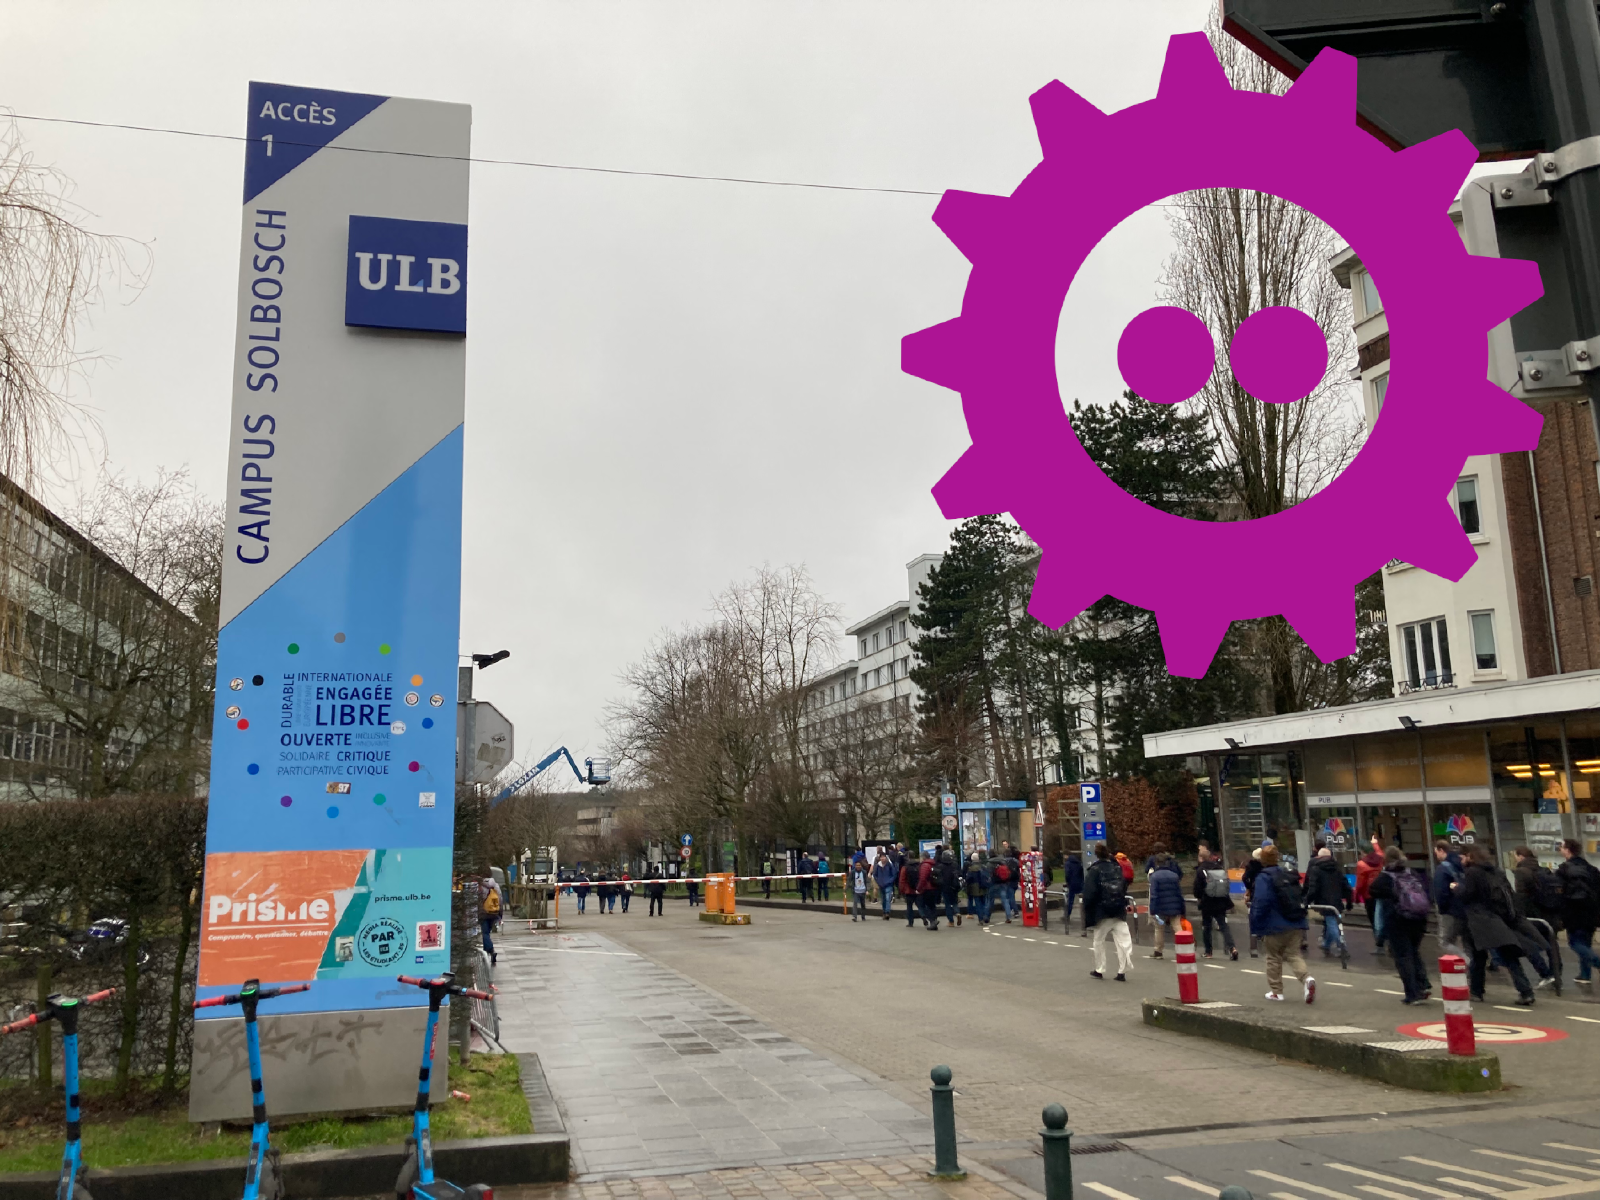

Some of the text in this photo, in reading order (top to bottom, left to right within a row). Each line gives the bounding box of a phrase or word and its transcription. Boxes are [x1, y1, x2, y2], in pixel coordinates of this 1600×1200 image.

[259, 101, 337, 126] ACCÈS
[261, 134, 274, 157] 1
[355, 252, 461, 295] ULB
[236, 208, 287, 564] CAMPUS SOLBOSCH
[297, 672, 393, 682] INTERNATIONALE
[316, 684, 393, 701] ENGAGÉE
[281, 673, 295, 728] DURABLE
[315, 704, 391, 726] LIBRE
[280, 733, 352, 747] OUVERTE
[355, 732, 391, 740] INCLUSIVE
[279, 751, 331, 761] SOLIDAIRE
[336, 750, 391, 762] CRITIQUE
[277, 765, 344, 776] PARTICIPATIVE
[346, 765, 389, 776] CIVIQUE
[1081, 786, 1096, 803] P
[1326, 835, 1345, 844] PUB
[1450, 834, 1475, 845] PUB
[371, 930, 395, 943] PAR
